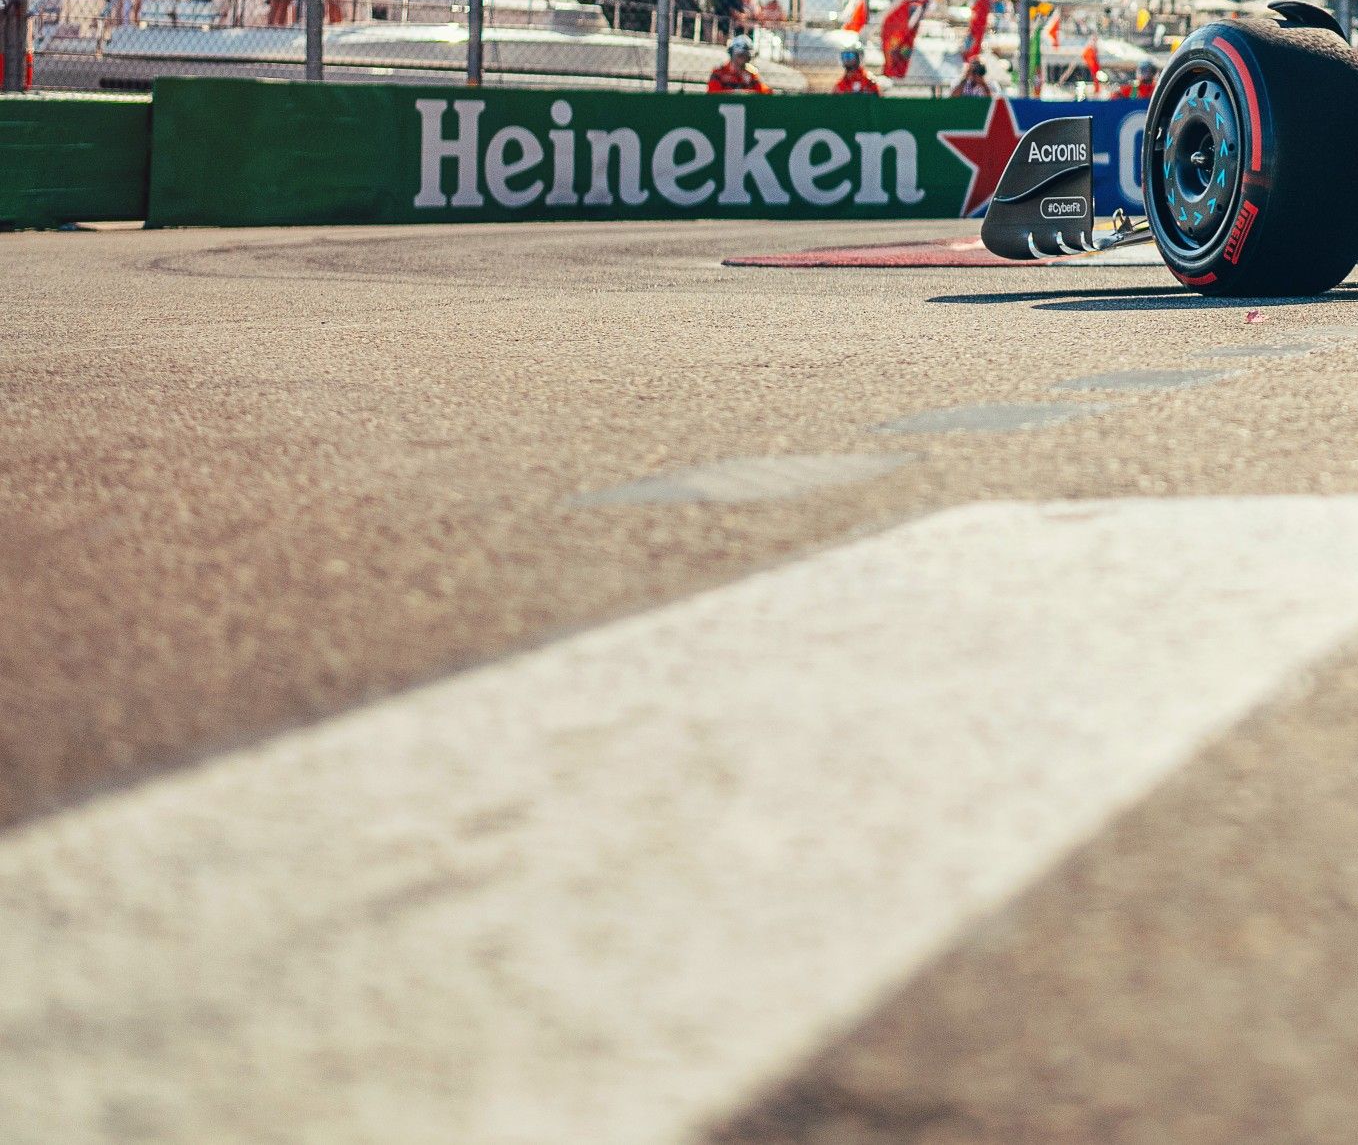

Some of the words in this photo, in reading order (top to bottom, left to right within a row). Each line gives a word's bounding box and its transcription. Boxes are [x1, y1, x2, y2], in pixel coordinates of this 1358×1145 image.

[414, 99, 925, 208] Heineken
[1028, 142, 1087, 163] Acronis
[1048, 202, 1081, 215] #CyberFit
[1223, 200, 1259, 265] PIRELLI
